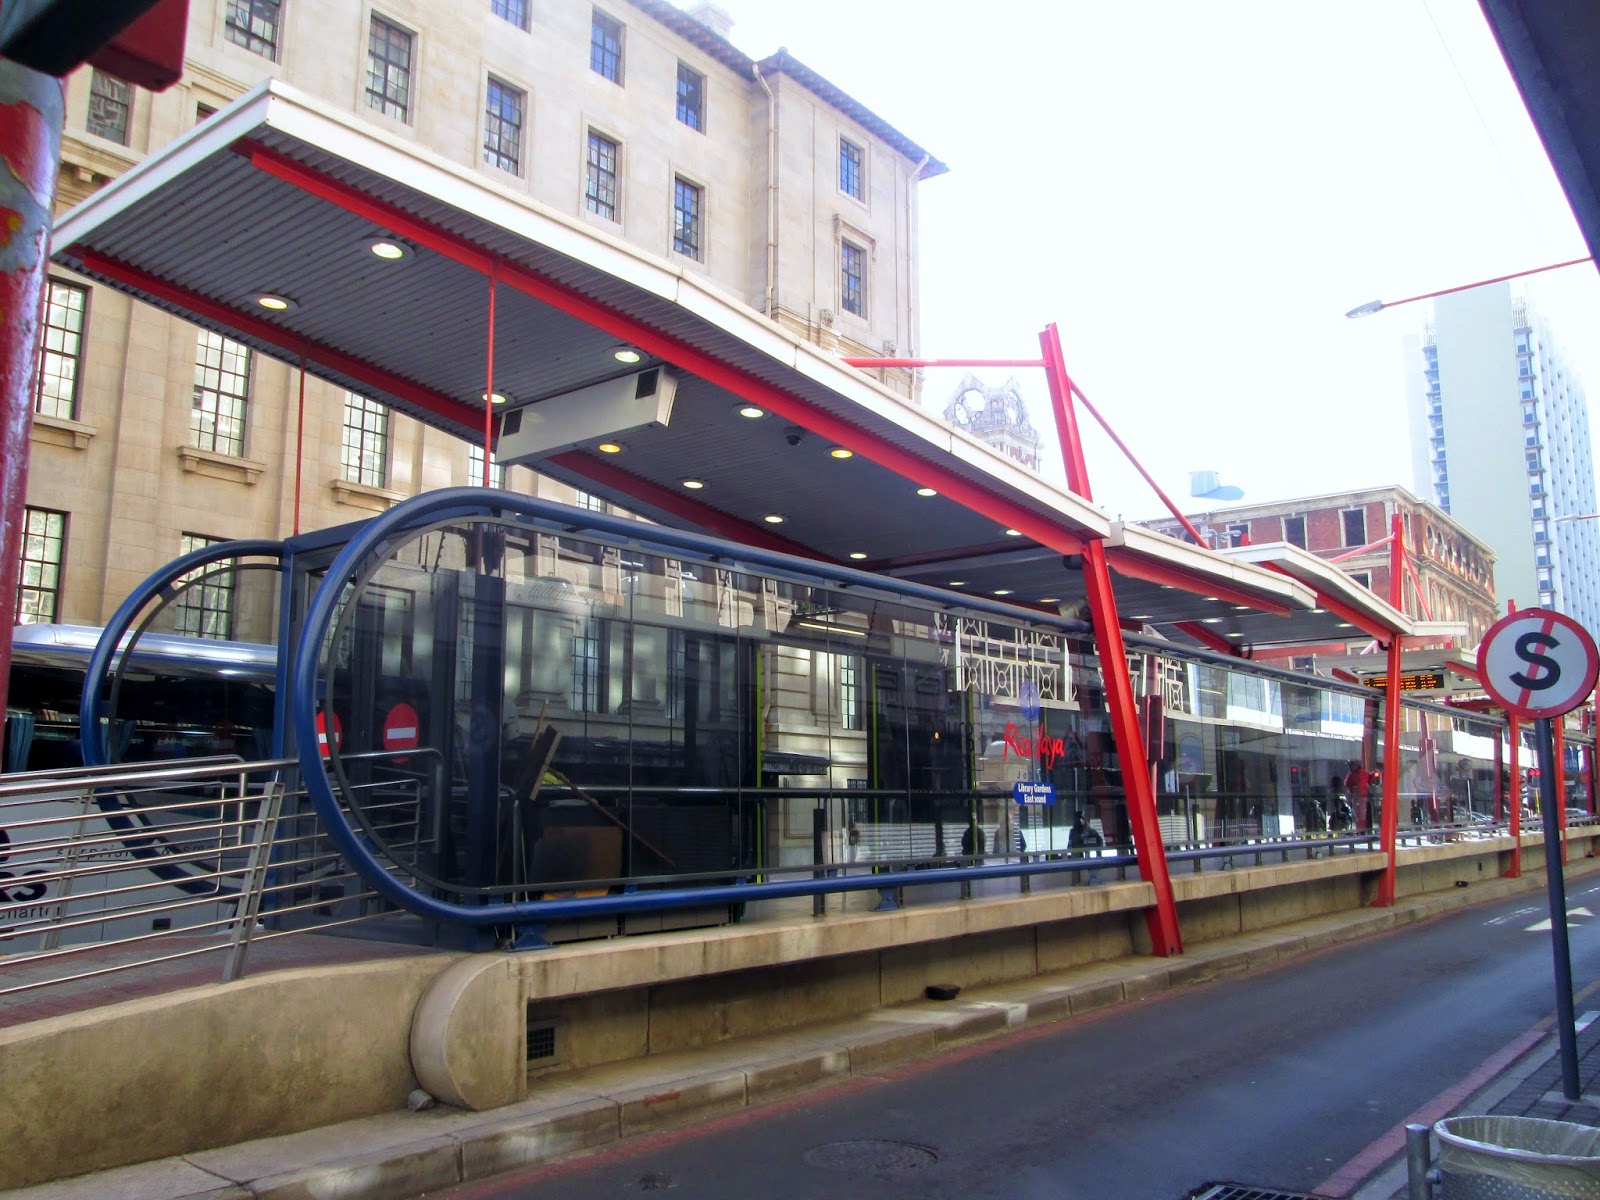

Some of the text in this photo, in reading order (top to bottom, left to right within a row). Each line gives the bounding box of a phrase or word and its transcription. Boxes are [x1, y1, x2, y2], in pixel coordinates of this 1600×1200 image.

[1509, 632, 1560, 690] S
[1003, 720, 1033, 761] Rea
[1018, 783, 1051, 795] Library Gardens
